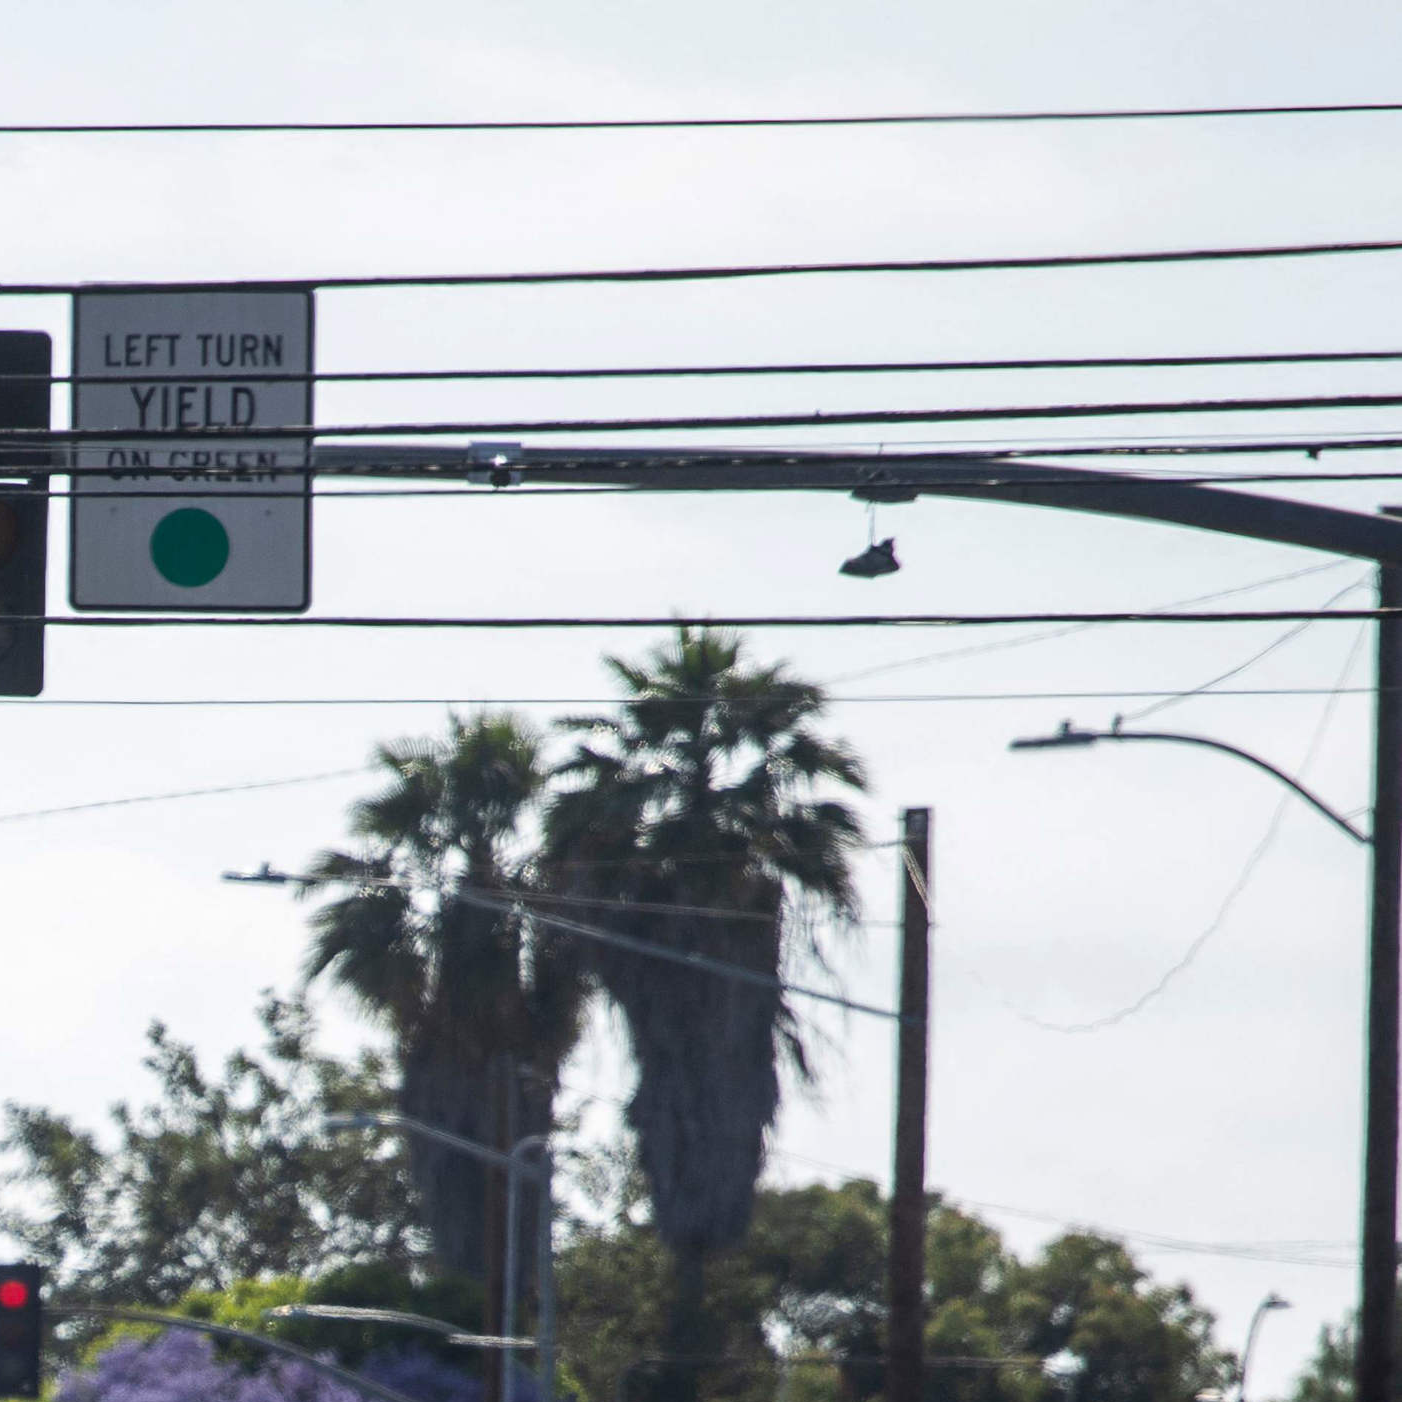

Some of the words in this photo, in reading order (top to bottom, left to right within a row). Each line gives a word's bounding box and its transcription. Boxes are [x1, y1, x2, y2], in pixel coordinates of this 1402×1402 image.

[104, 333, 180, 367] LEFT
[196, 333, 283, 367] TURN
[130, 386, 256, 429] YIELD
[107, 449, 150, 481] ON
[169, 450, 277, 482] GREEN
